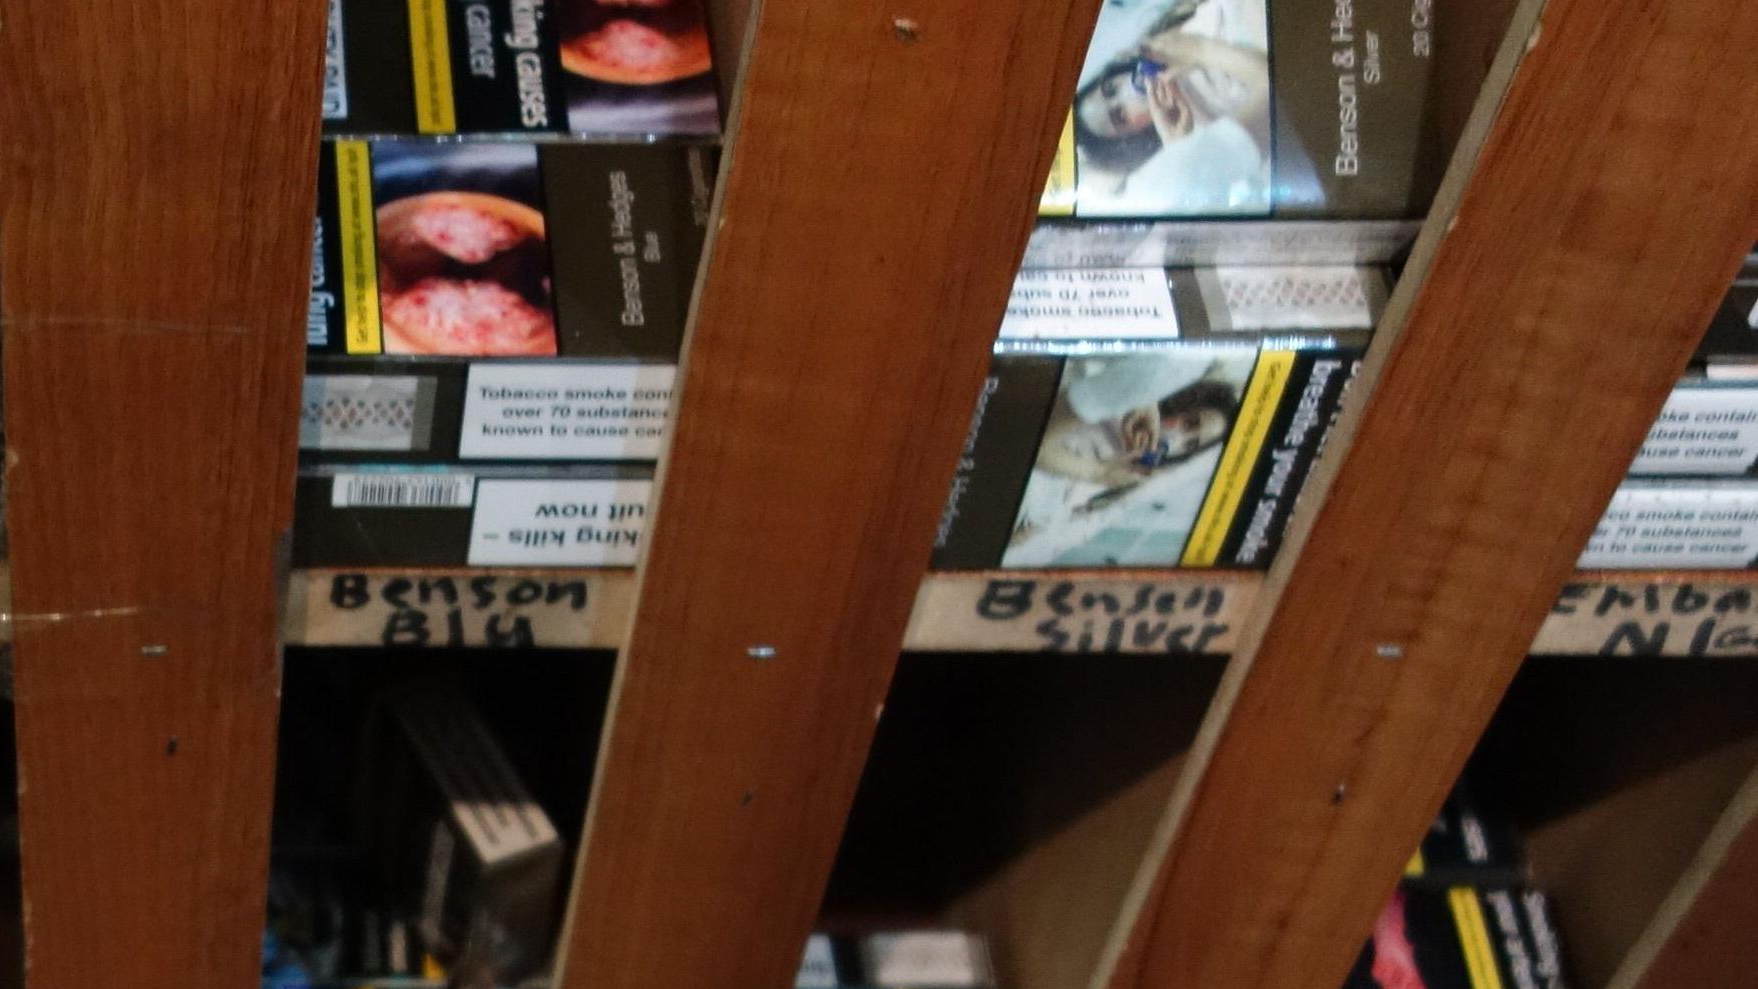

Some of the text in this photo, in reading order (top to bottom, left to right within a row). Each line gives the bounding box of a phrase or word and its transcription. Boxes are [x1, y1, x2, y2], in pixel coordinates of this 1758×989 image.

[465, 4, 496, 77] cancer
[504, 0, 548, 127] king causes
[1335, 74, 1358, 176] Benson
[608, 171, 635, 237] Hedges
[621, 262, 645, 326] Benson
[480, 386, 558, 399] Tobacco
[565, 386, 627, 399] smoke
[503, 406, 669, 419] over 70 substanc
[1657, 409, 1690, 422] oke
[482, 425, 543, 437] known
[551, 425, 567, 437] to
[573, 426, 628, 437] cause
[535, 503, 645, 519] uit now
[508, 527, 638, 547] king kills
